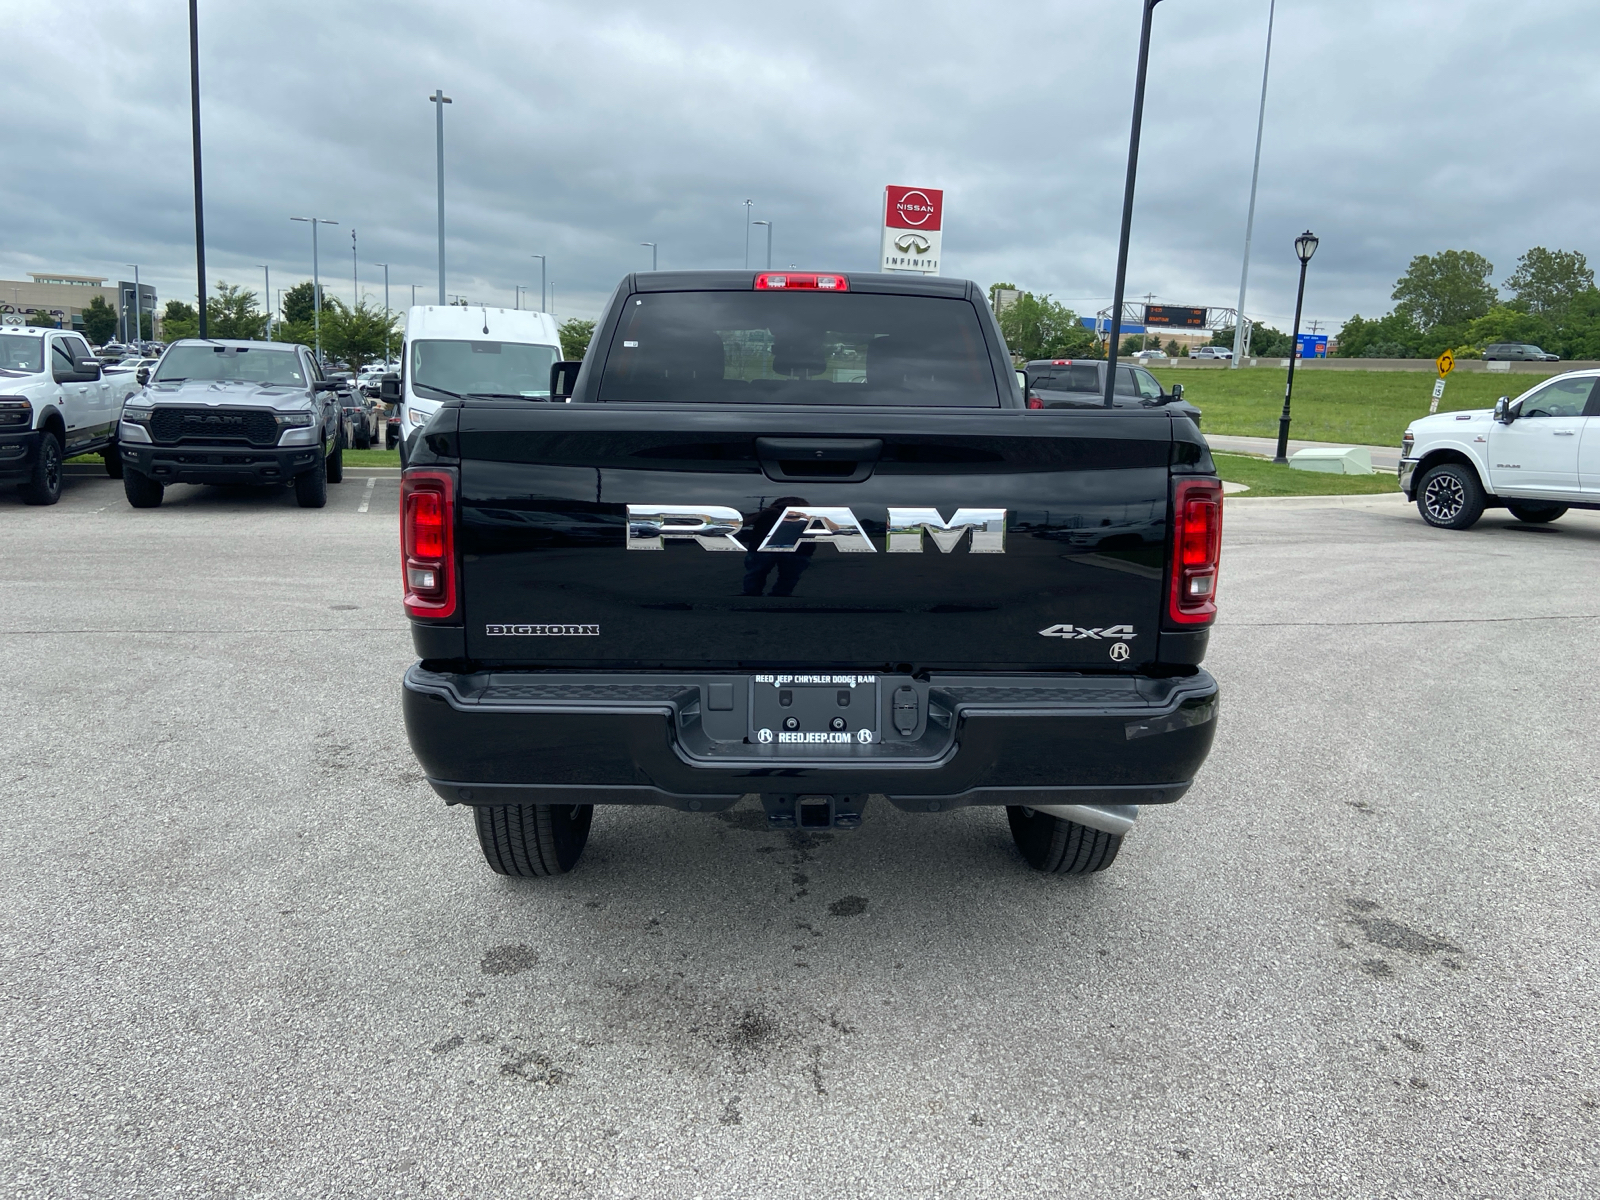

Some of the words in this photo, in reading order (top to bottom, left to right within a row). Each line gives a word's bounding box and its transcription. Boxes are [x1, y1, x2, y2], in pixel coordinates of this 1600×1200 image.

[896, 203, 934, 213] NISSAN
[886, 256, 937, 268] INFINITI
[184, 415, 243, 424] RAM
[626, 504, 1008, 554] RAM
[485, 624, 600, 636] BIGHORN
[1038, 624, 1138, 640] 4x4
[755, 674, 774, 683] REED
[776, 674, 793, 683] JEEP
[794, 675, 831, 683] CHRYSLER
[832, 675, 856, 684] DODGE
[857, 675, 875, 683] RAM
[778, 732, 851, 743] REEDJEEP.COM
